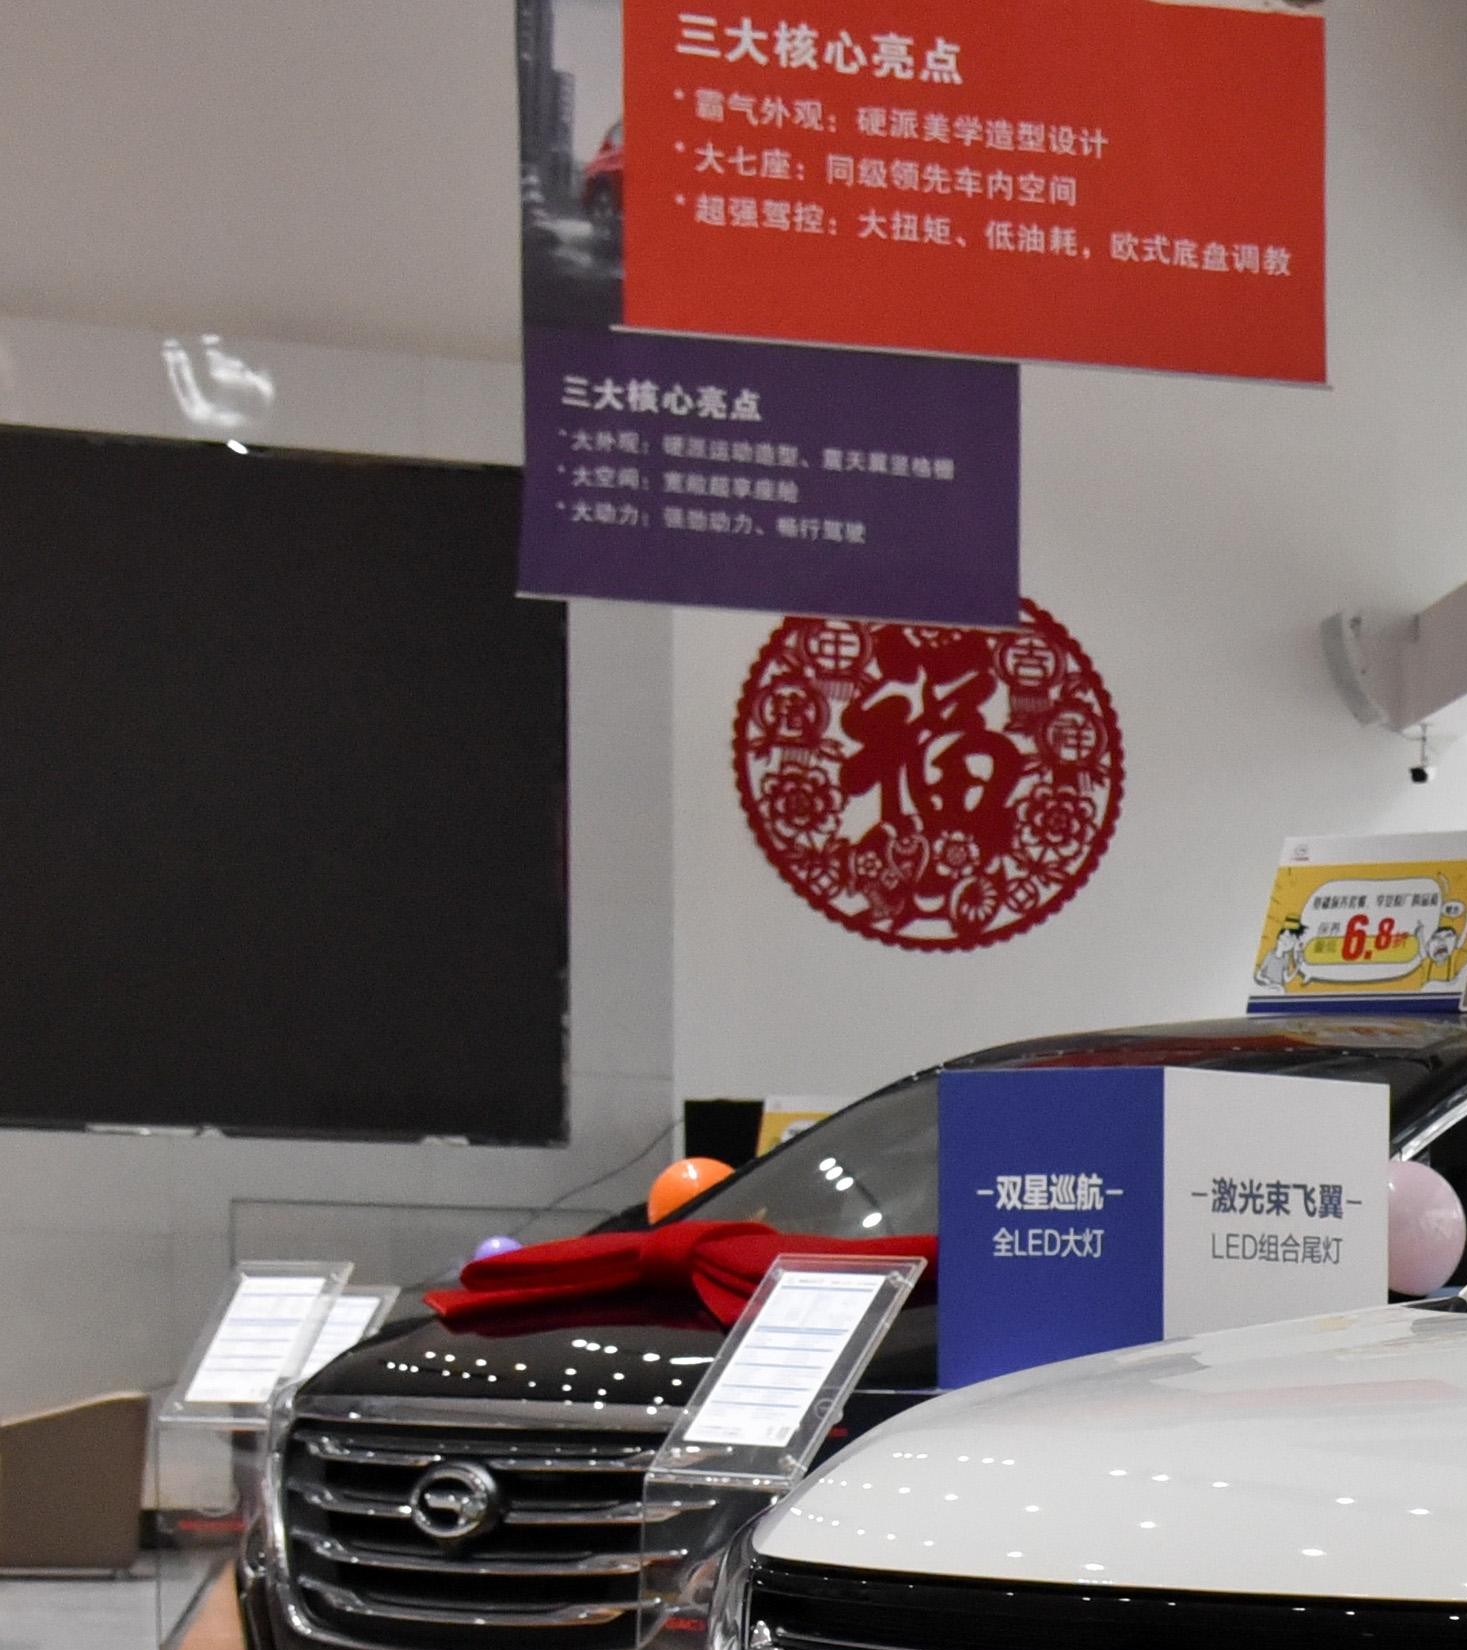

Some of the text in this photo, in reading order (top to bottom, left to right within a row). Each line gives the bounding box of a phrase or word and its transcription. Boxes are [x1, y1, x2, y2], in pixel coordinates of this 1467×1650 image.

[675, 12, 963, 85] 三大核心亮点
[694, 141, 1077, 206] 大七座：同级领先车内空间
[561, 374, 763, 422] 三大核心亮点
[994, 1174, 1105, 1212] 双星巡航
[1210, 1177, 1345, 1220] 激光束飞翼
[992, 1228, 1105, 1259] 全LED大灯
[1210, 1232, 1344, 1266] LED组合尾灯
